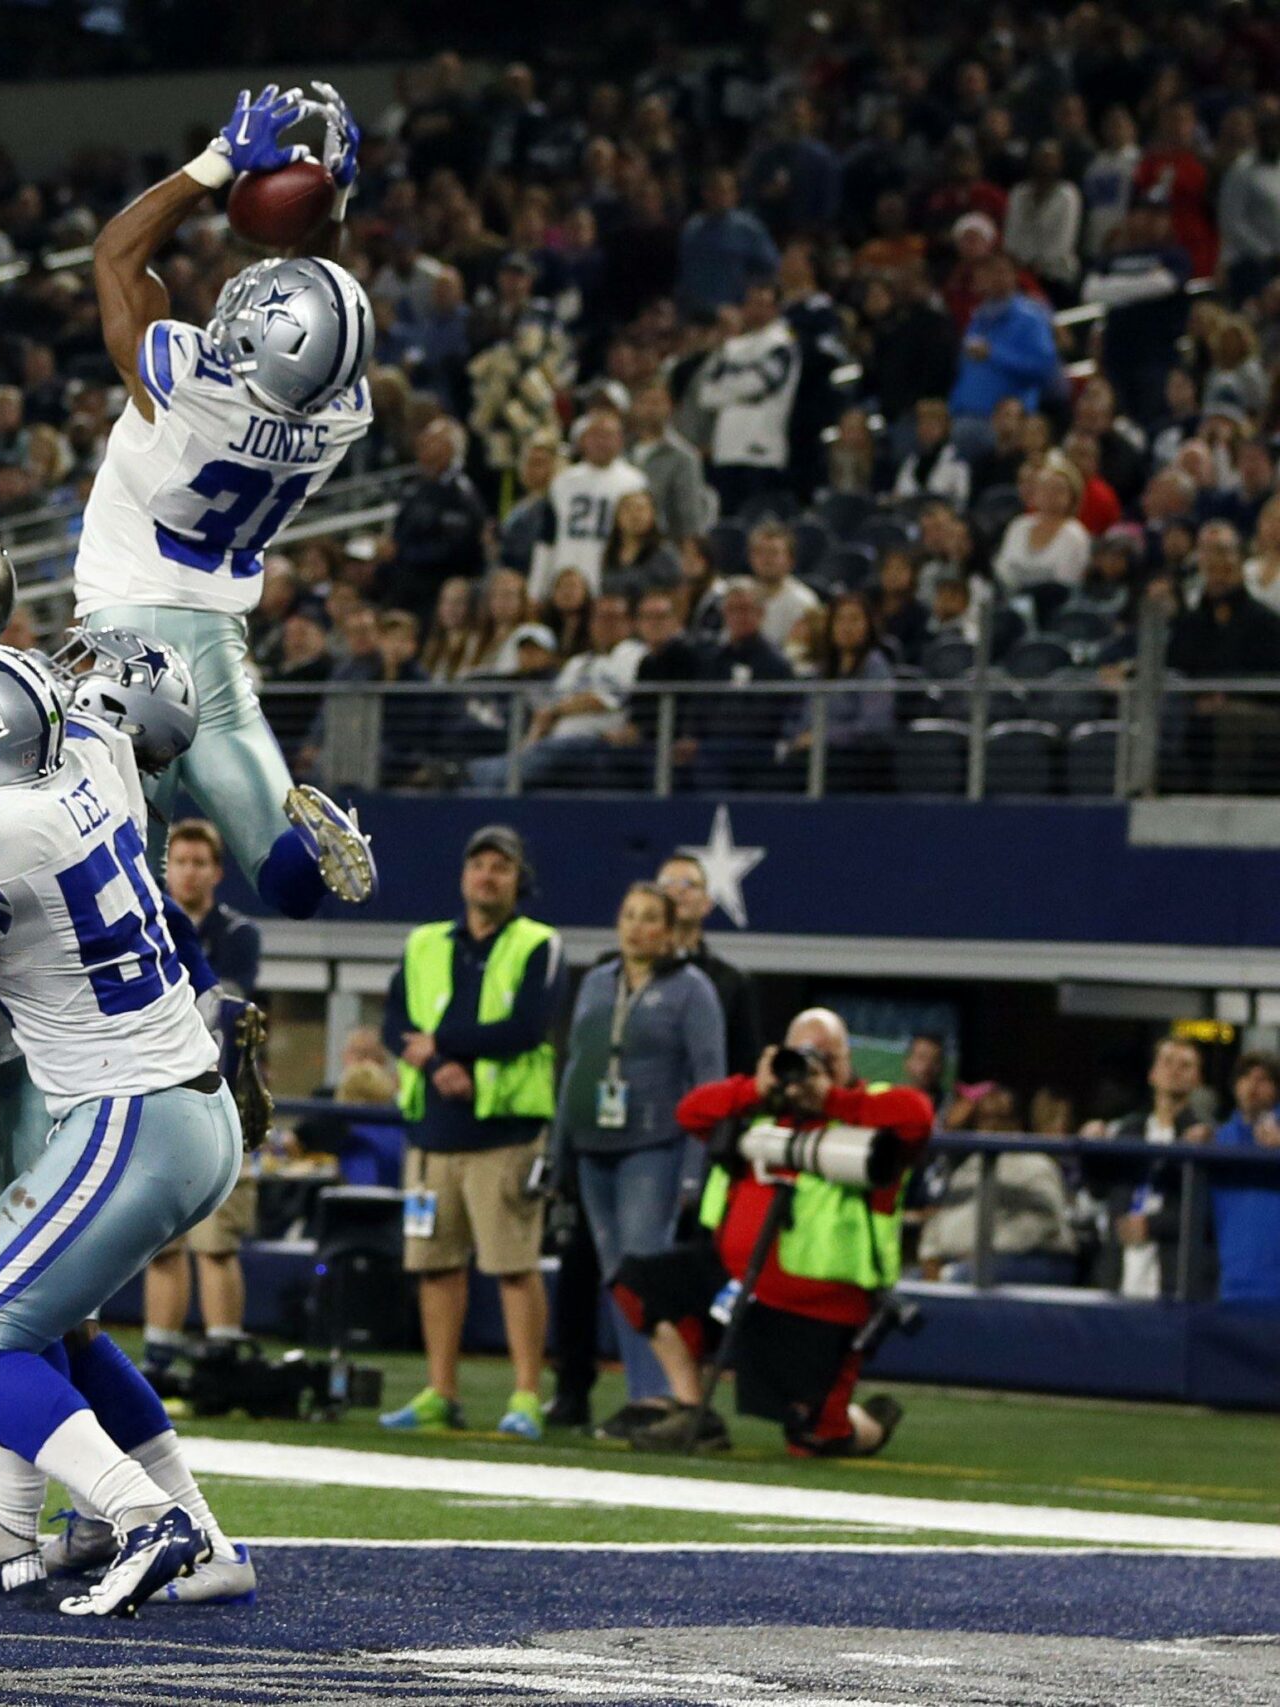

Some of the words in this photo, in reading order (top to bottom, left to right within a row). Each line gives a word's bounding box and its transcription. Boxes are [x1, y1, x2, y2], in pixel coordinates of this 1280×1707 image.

[228, 415, 329, 463] JONES
[154, 459, 314, 579] 31
[567, 498, 608, 540] 21
[59, 778, 111, 837] LEE
[55, 816, 183, 1016] 50
